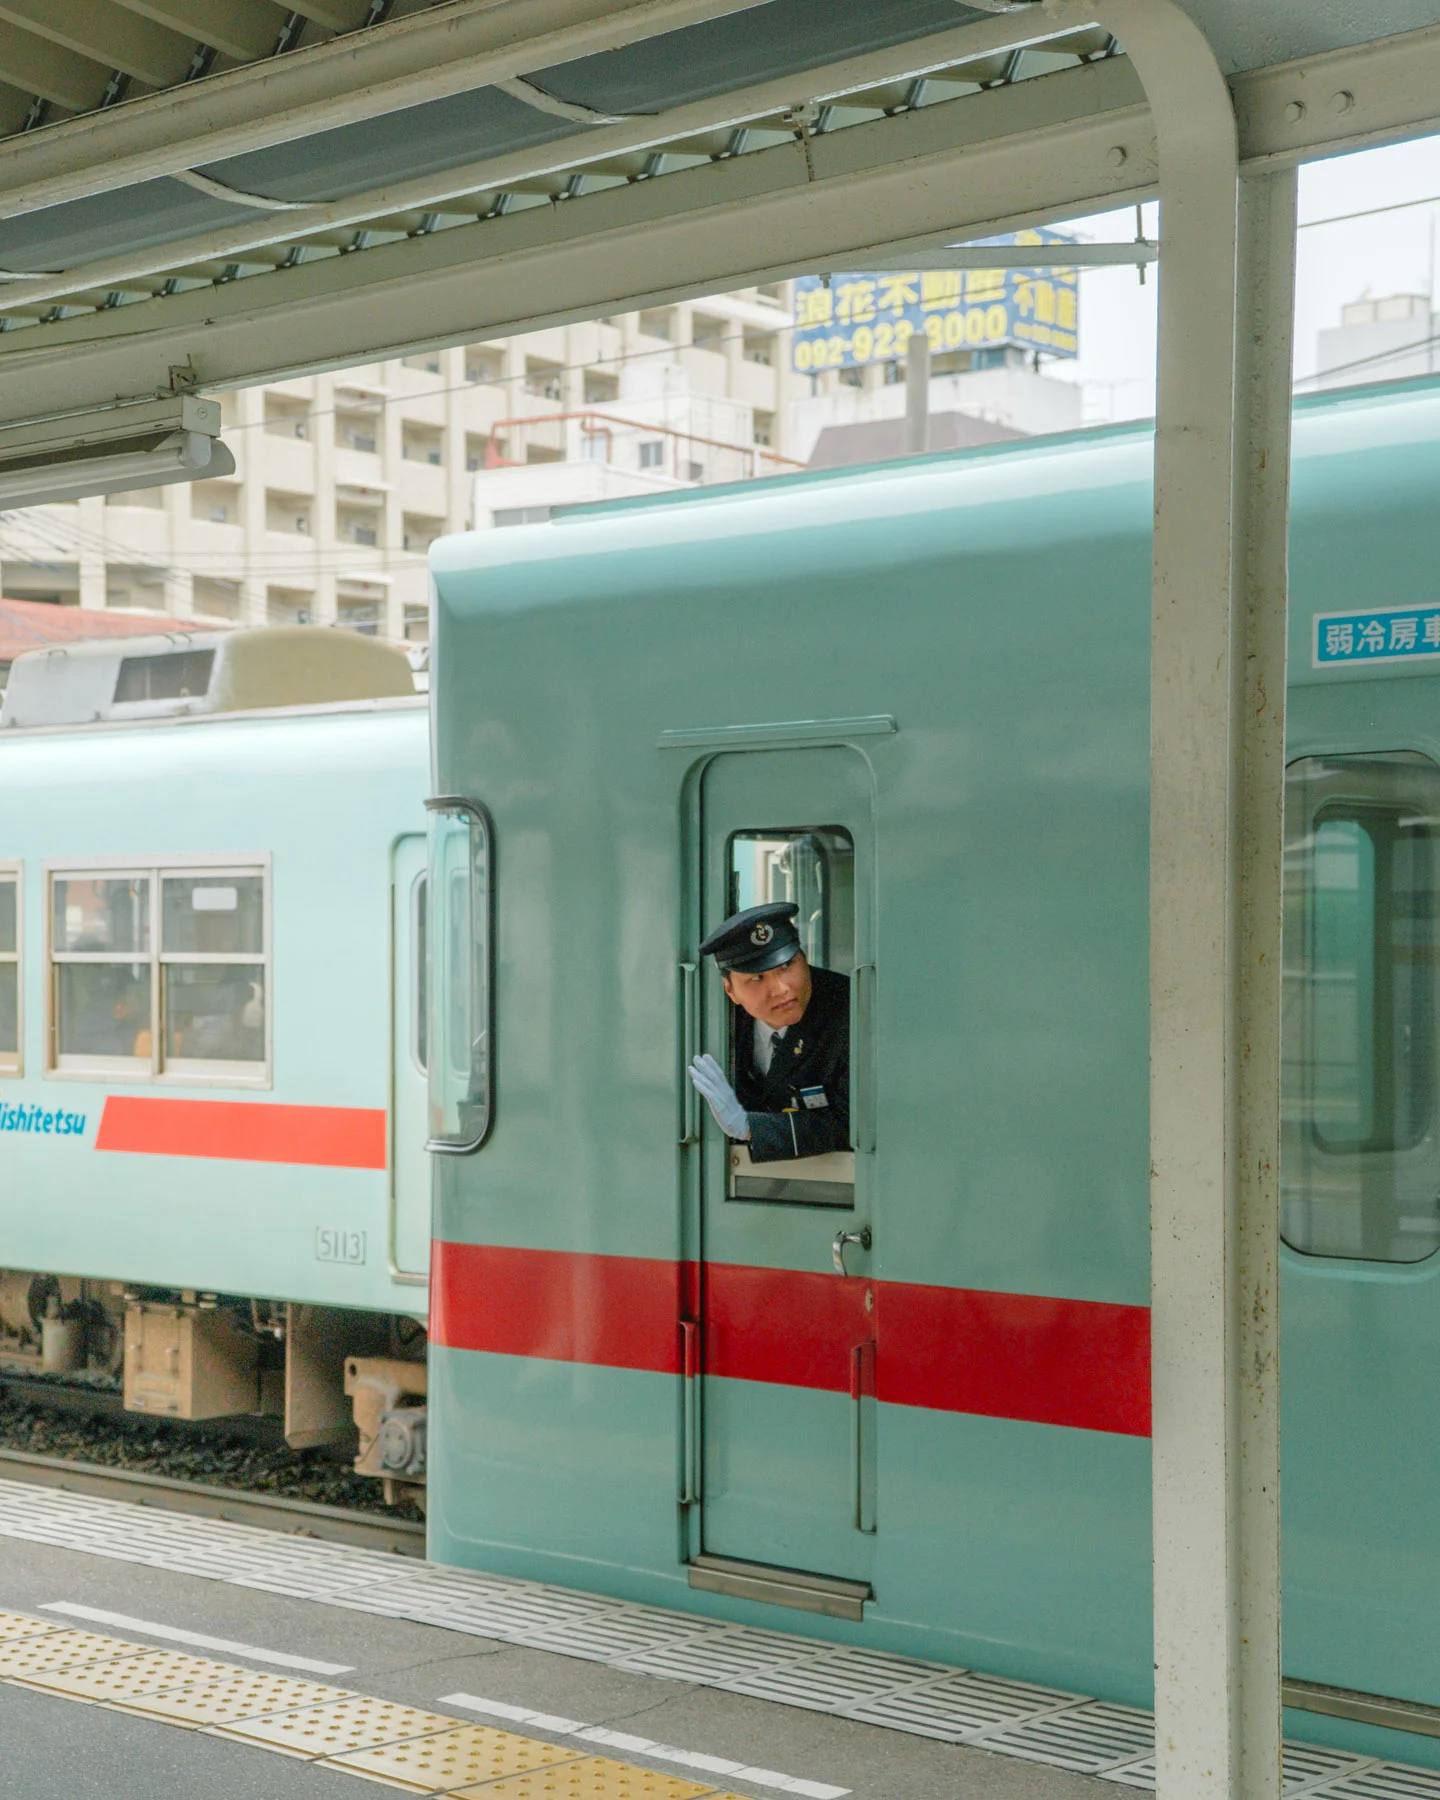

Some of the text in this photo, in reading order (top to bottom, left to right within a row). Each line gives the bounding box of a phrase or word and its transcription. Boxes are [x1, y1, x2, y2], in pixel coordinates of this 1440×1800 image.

[1326, 614, 1440, 655] 弱冷房車
[0, 1103, 86, 1135] ishitetsu
[320, 1230, 360, 1260] 5113
